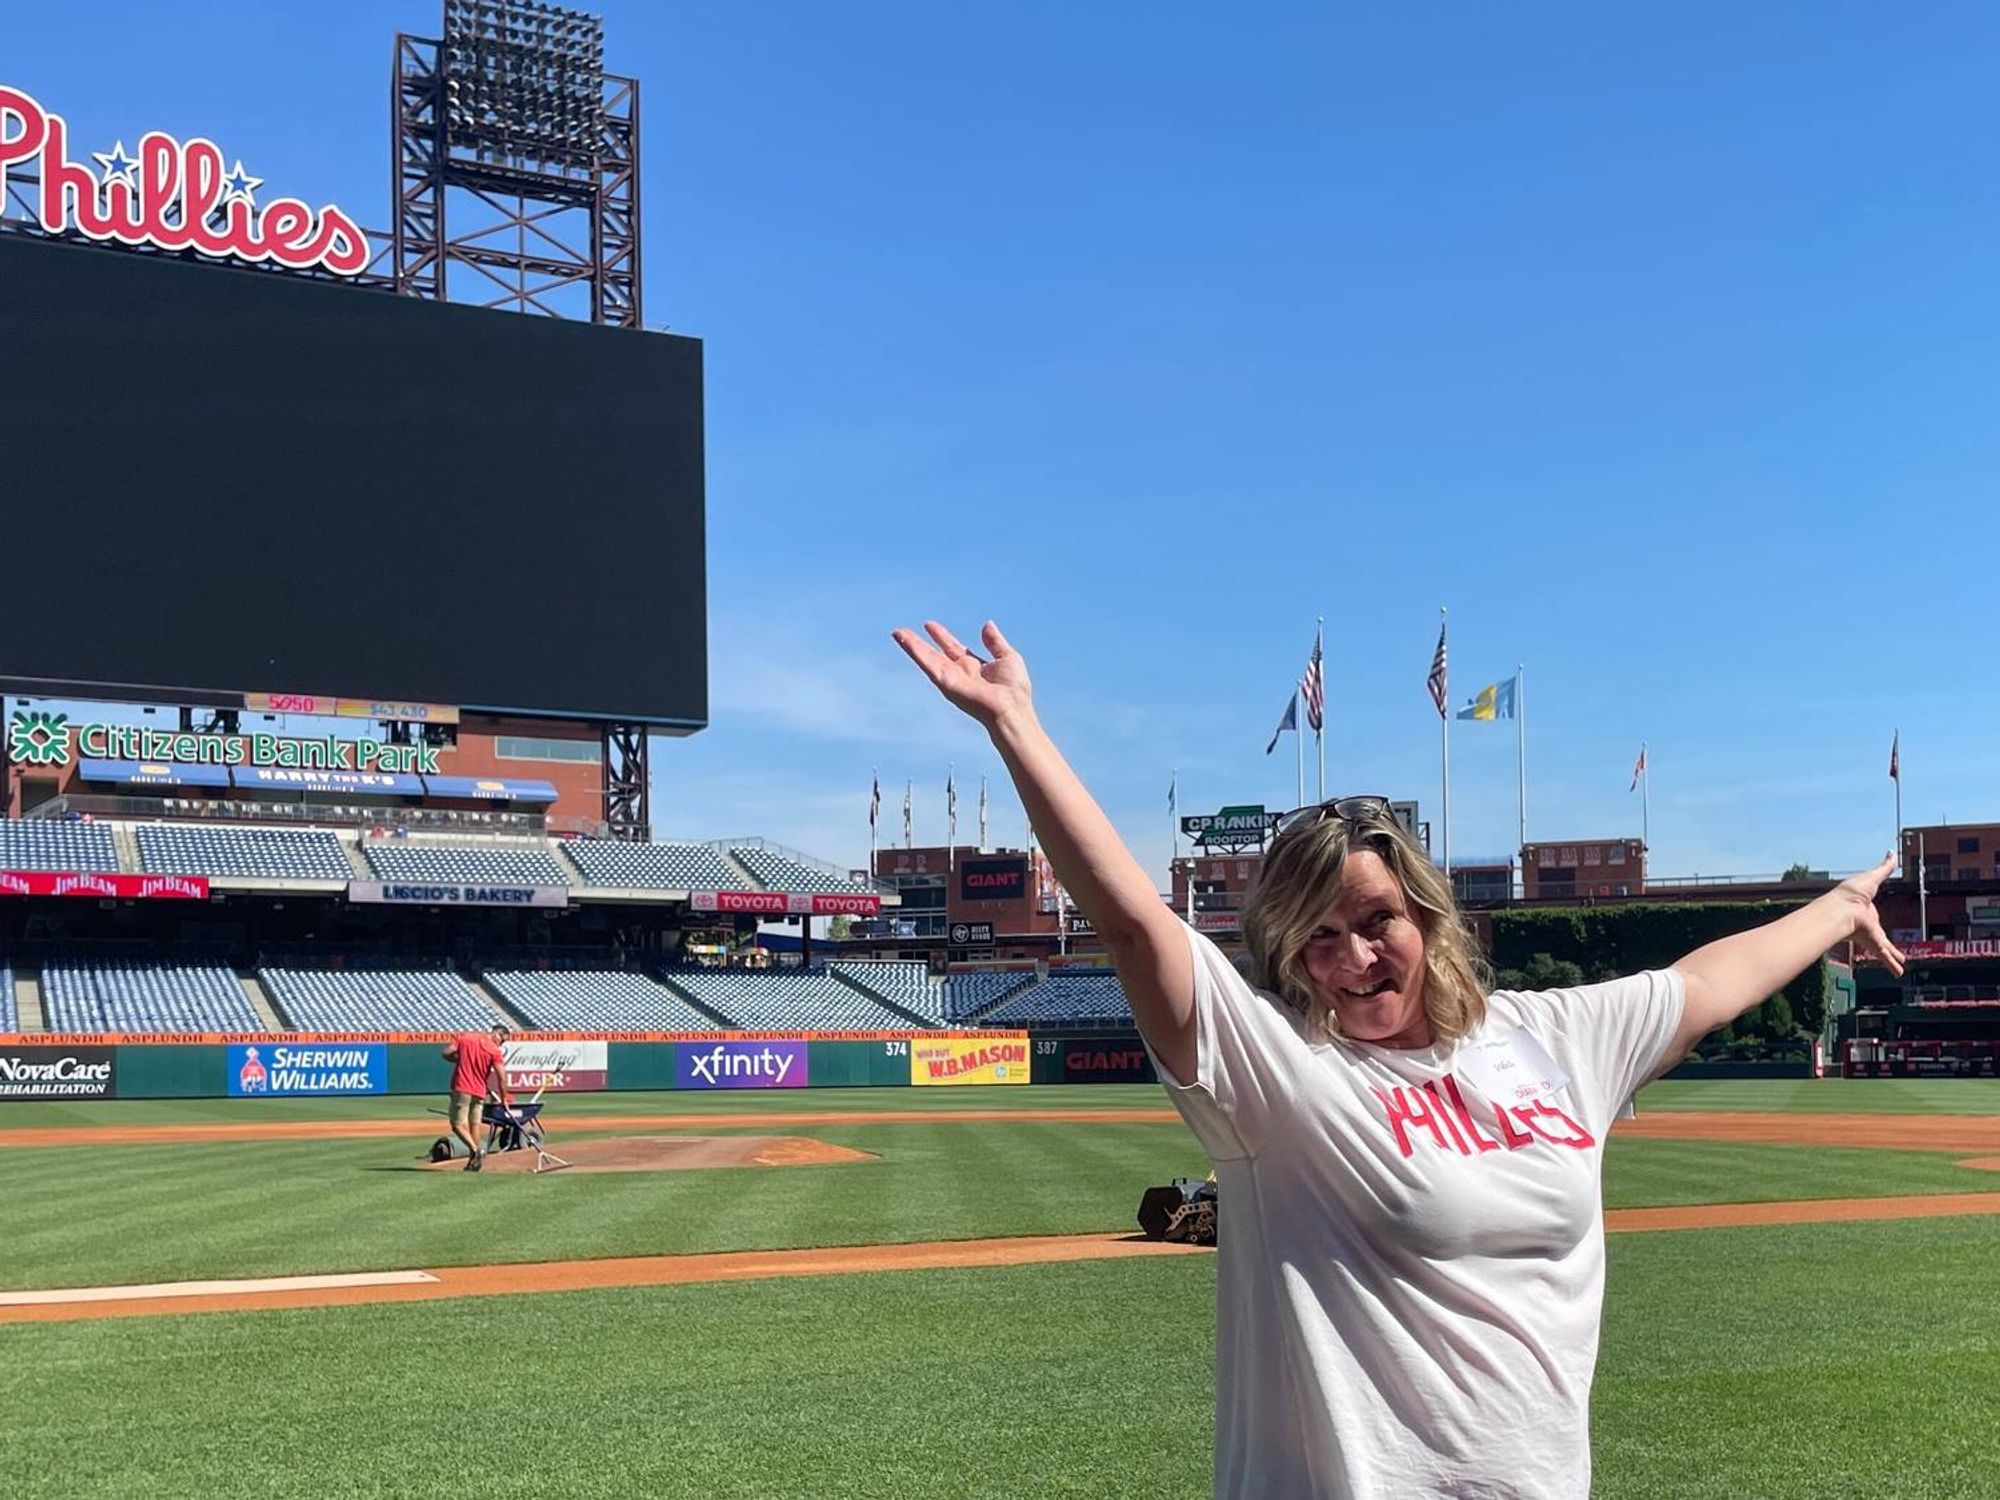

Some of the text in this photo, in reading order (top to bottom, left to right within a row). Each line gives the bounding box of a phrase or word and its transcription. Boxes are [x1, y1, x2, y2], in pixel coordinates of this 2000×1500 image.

[0, 84, 370, 276] Phillies
[79, 723, 441, 774] Citizens Bank Park
[1204, 834, 1259, 845] ROOFTOP
[51, 872, 117, 897] JIM BEAM
[138, 874, 201, 899] JIM BEAM
[966, 872, 1019, 888] GIANT
[464, 887, 536, 903] BAKERY
[722, 895, 784, 910] TOYOTA
[818, 898, 877, 912] TOYOTA
[19, 1034, 104, 1044] ASPLUNDH
[121, 1034, 203, 1044] ASPLUNDH
[219, 1034, 299, 1044] ASPLUNDH
[314, 1033, 390, 1043] ASPLUNDH
[578, 1032, 647, 1042] ASPLUNDH
[661, 1032, 727, 1041] ASPLUNDH
[739, 1032, 803, 1041] ASPLUNDH
[815, 1031, 878, 1040] ASPLUNDH
[889, 1031, 949, 1039] ASPLUNDH
[962, 1031, 1020, 1039] ASPLUNDH
[885, 1041, 907, 1056] 374
[1036, 1041, 1058, 1055] 387
[271, 1048, 369, 1068] SHERWIN
[690, 1046, 794, 1084] xfinity
[1065, 1051, 1144, 1070] GIANT
[0, 1057, 111, 1081] NovaCare
[507, 1073, 564, 1087] LAGER
